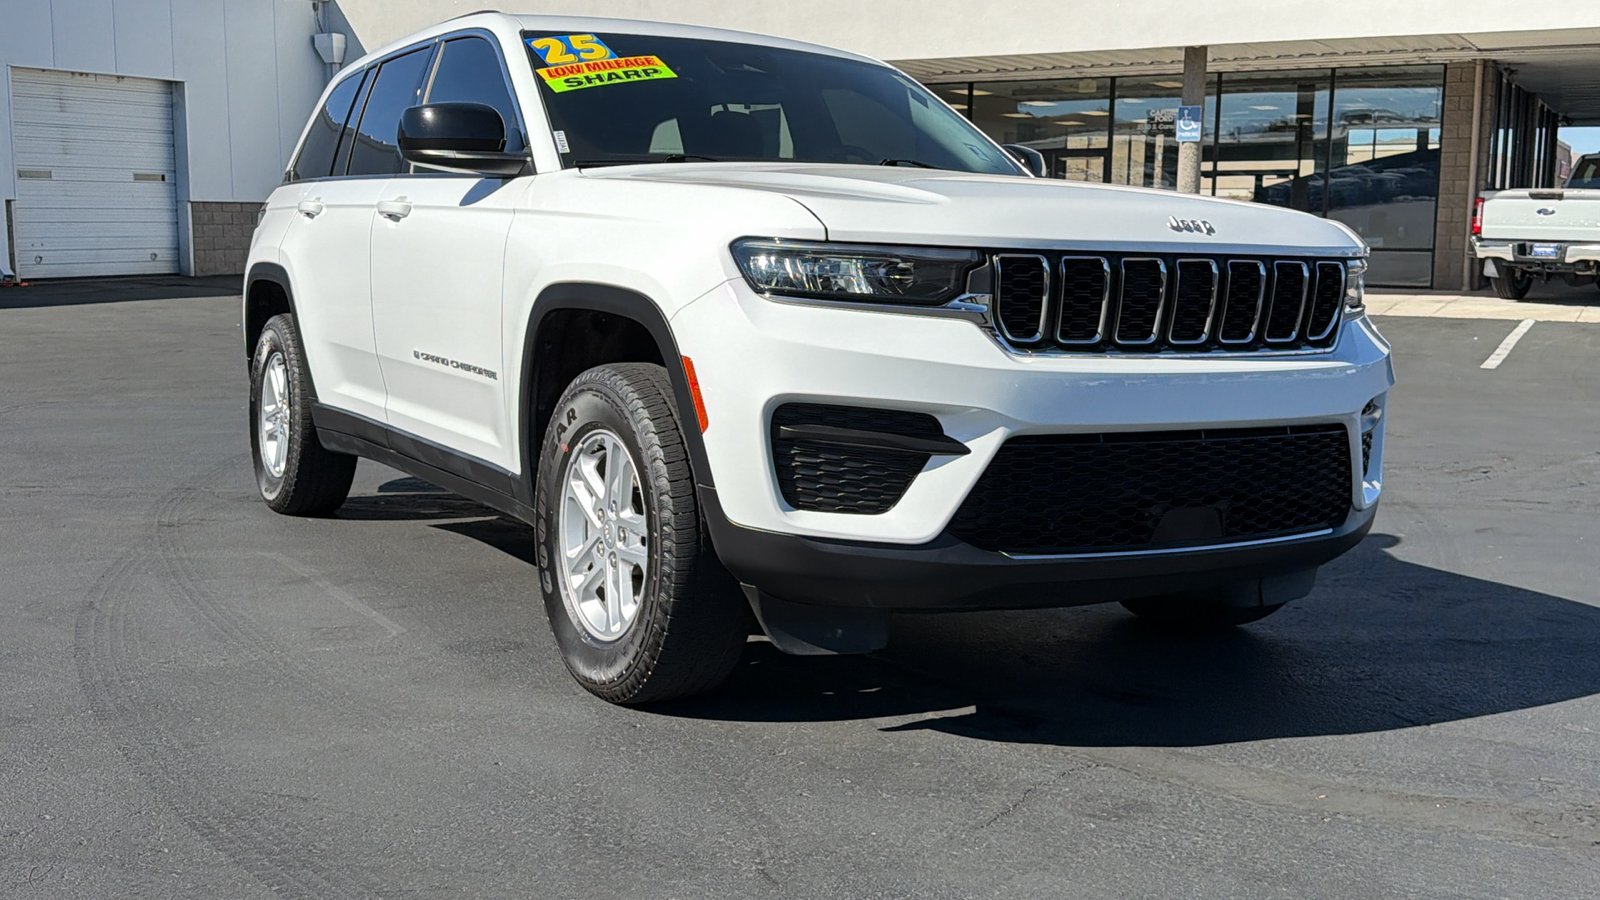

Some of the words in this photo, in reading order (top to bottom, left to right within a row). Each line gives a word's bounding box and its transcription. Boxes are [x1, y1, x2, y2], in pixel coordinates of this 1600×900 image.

[531, 34, 611, 65] 25
[546, 65, 584, 79] LOW
[586, 57, 659, 73] MILEAGE
[563, 67, 663, 88] SHARP
[1166, 215, 1216, 236] Jeep
